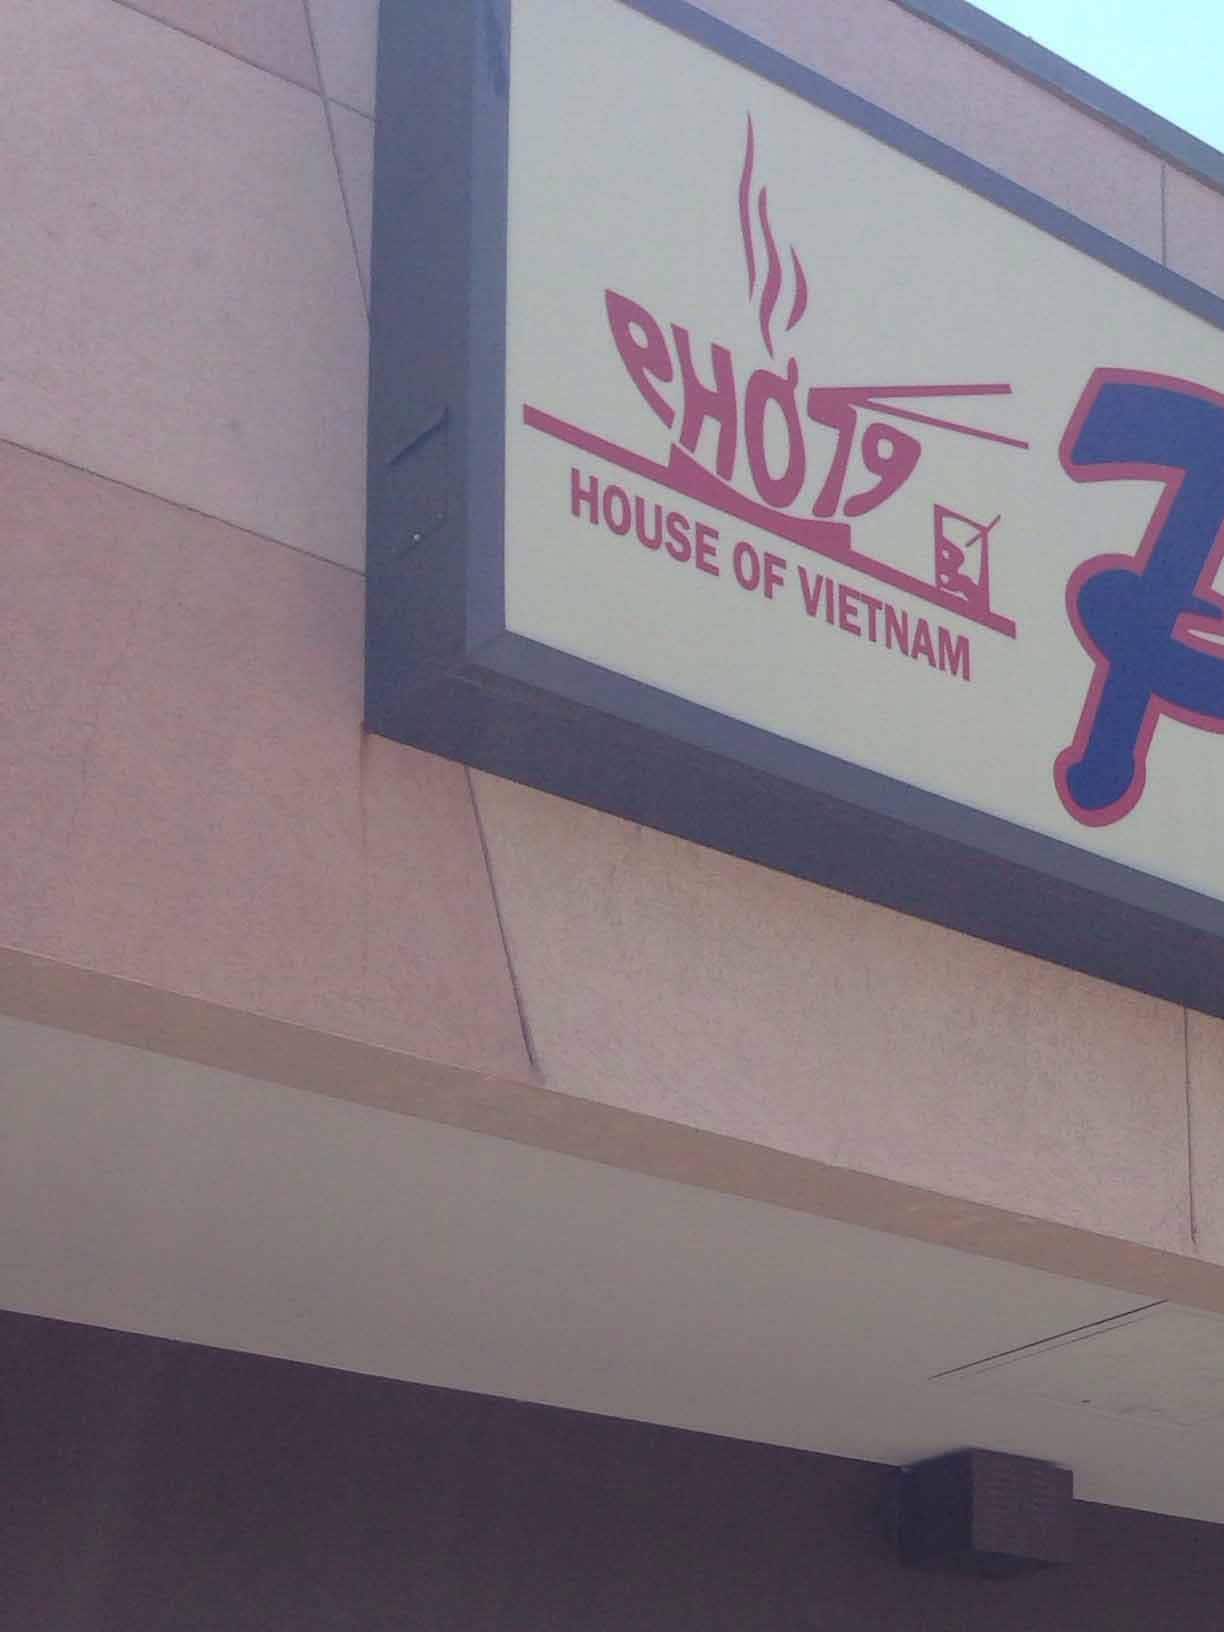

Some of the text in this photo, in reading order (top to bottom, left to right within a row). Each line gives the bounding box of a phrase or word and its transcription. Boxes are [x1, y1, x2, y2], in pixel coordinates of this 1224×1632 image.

[570, 466, 972, 682] HOUSE OF VIETNAM
